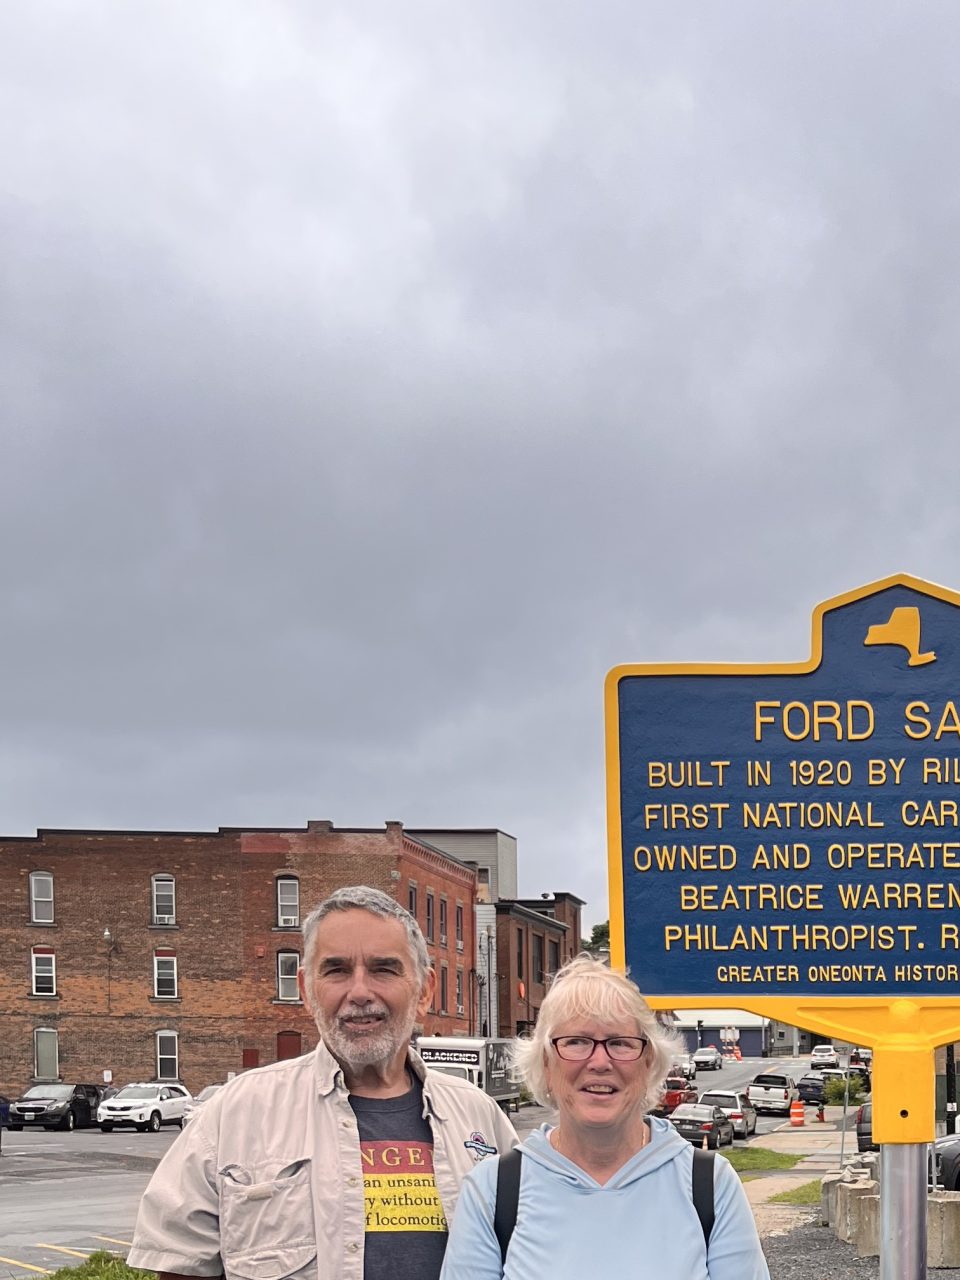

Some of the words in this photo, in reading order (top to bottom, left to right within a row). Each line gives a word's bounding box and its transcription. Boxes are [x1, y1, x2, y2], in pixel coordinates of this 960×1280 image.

[755, 699, 875, 742] FORD
[648, 761, 730, 787] BUILT
[747, 761, 771, 786] IN
[789, 760, 852, 786] 1920
[868, 759, 905, 785] BY
[644, 803, 730, 829] FIRST
[743, 802, 884, 828] NATIONAL
[901, 800, 959, 827] CAR
[634, 845, 737, 871] OWNED
[752, 844, 811, 870] AND
[680, 884, 823, 911] BEATRICE
[664, 925, 925, 951] PHILANTHROPIST.
[717, 965, 800, 983] GREATER
[808, 965, 887, 982] ONEONTA
[422, 1051, 478, 1063] BLACKENED
[361, 1147, 434, 1166] NGE
[381, 1192, 439, 1207] without
